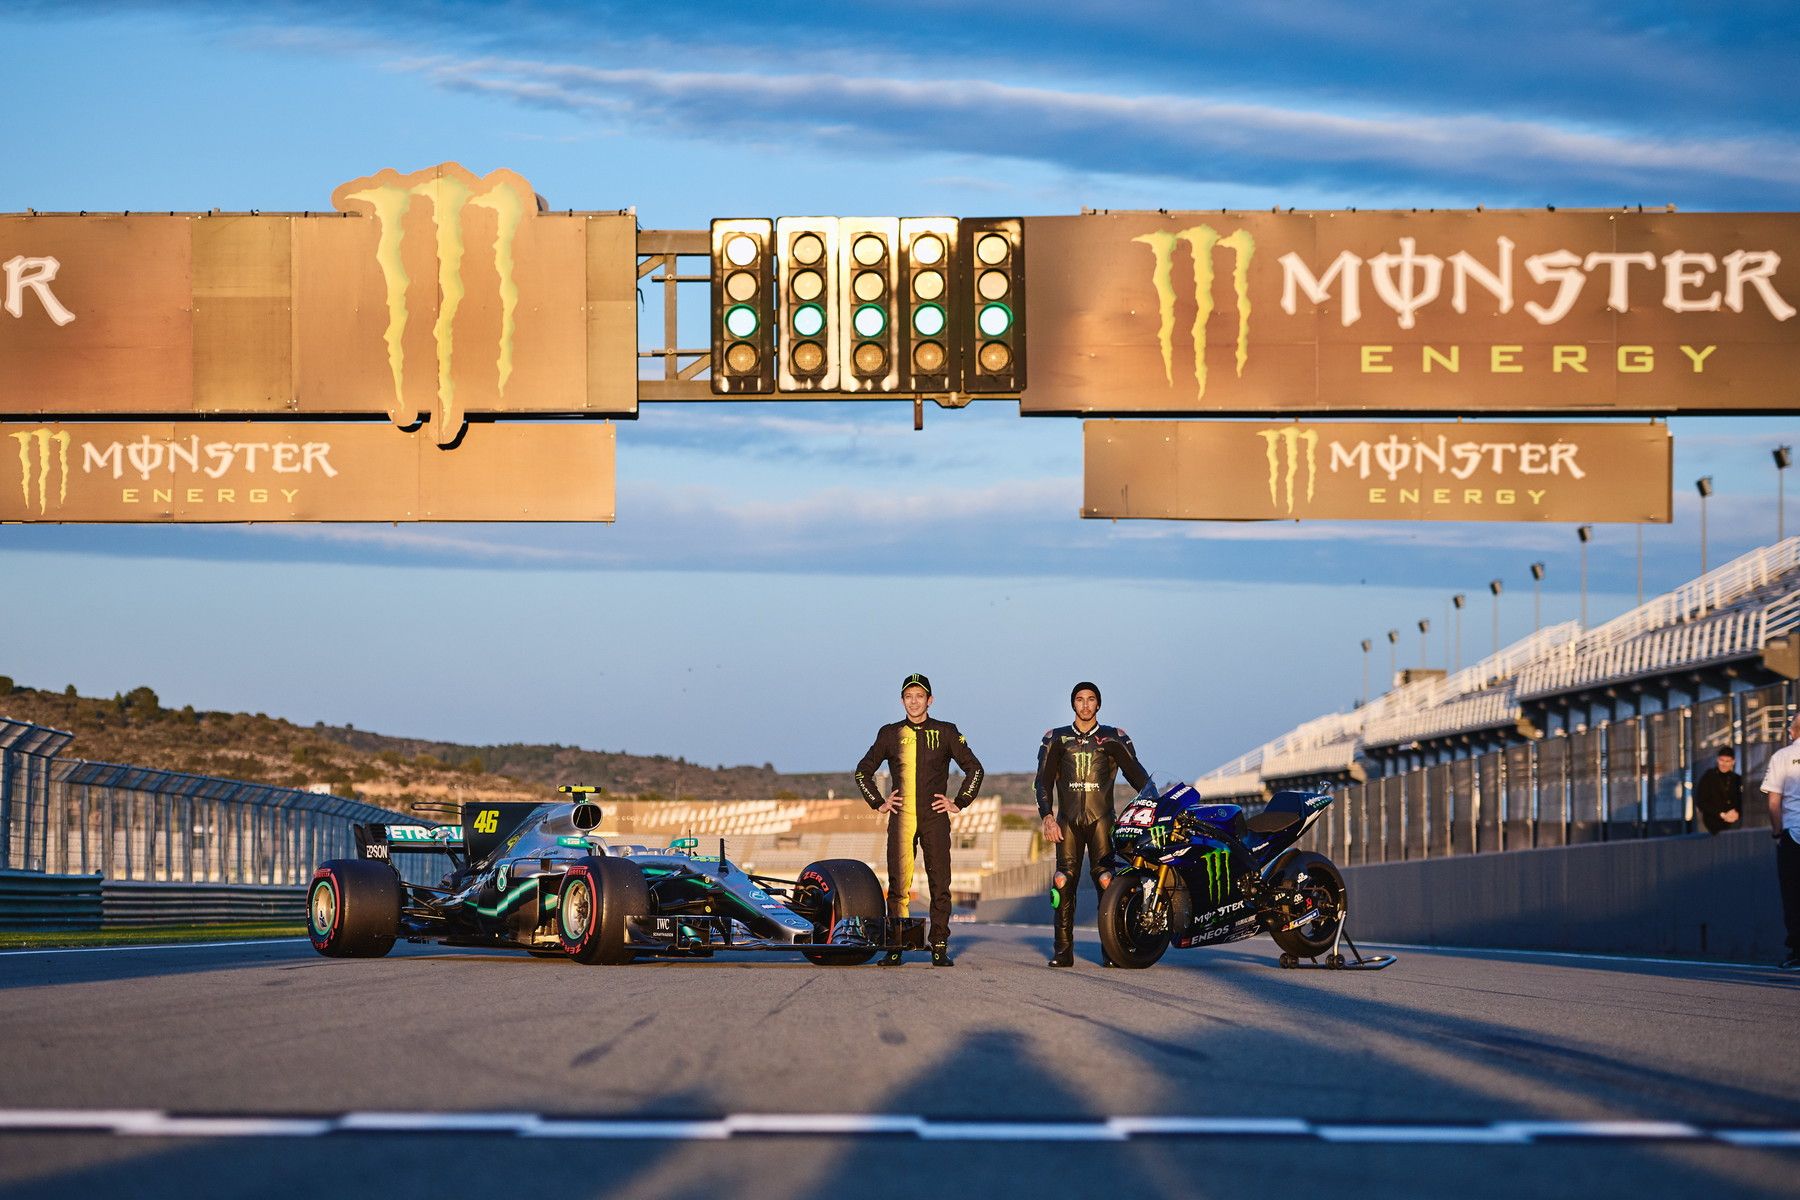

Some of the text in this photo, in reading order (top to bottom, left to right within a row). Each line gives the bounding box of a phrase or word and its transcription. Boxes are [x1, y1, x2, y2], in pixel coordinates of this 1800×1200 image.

[1277, 235, 1797, 330] MONSTER
[1360, 345, 1718, 374] ENERGY
[82, 434, 339, 481] MONSTER
[1328, 434, 1586, 481] MONSTER
[122, 488, 300, 503] ENERGY
[1368, 488, 1548, 505] ENERGY
[473, 810, 500, 834] 46
[1118, 808, 1155, 827] 44
[366, 844, 388, 859] EPSON
[803, 871, 830, 893] ZERO
[656, 918, 670, 930] IWC
[1191, 925, 1230, 945] ENEOS
